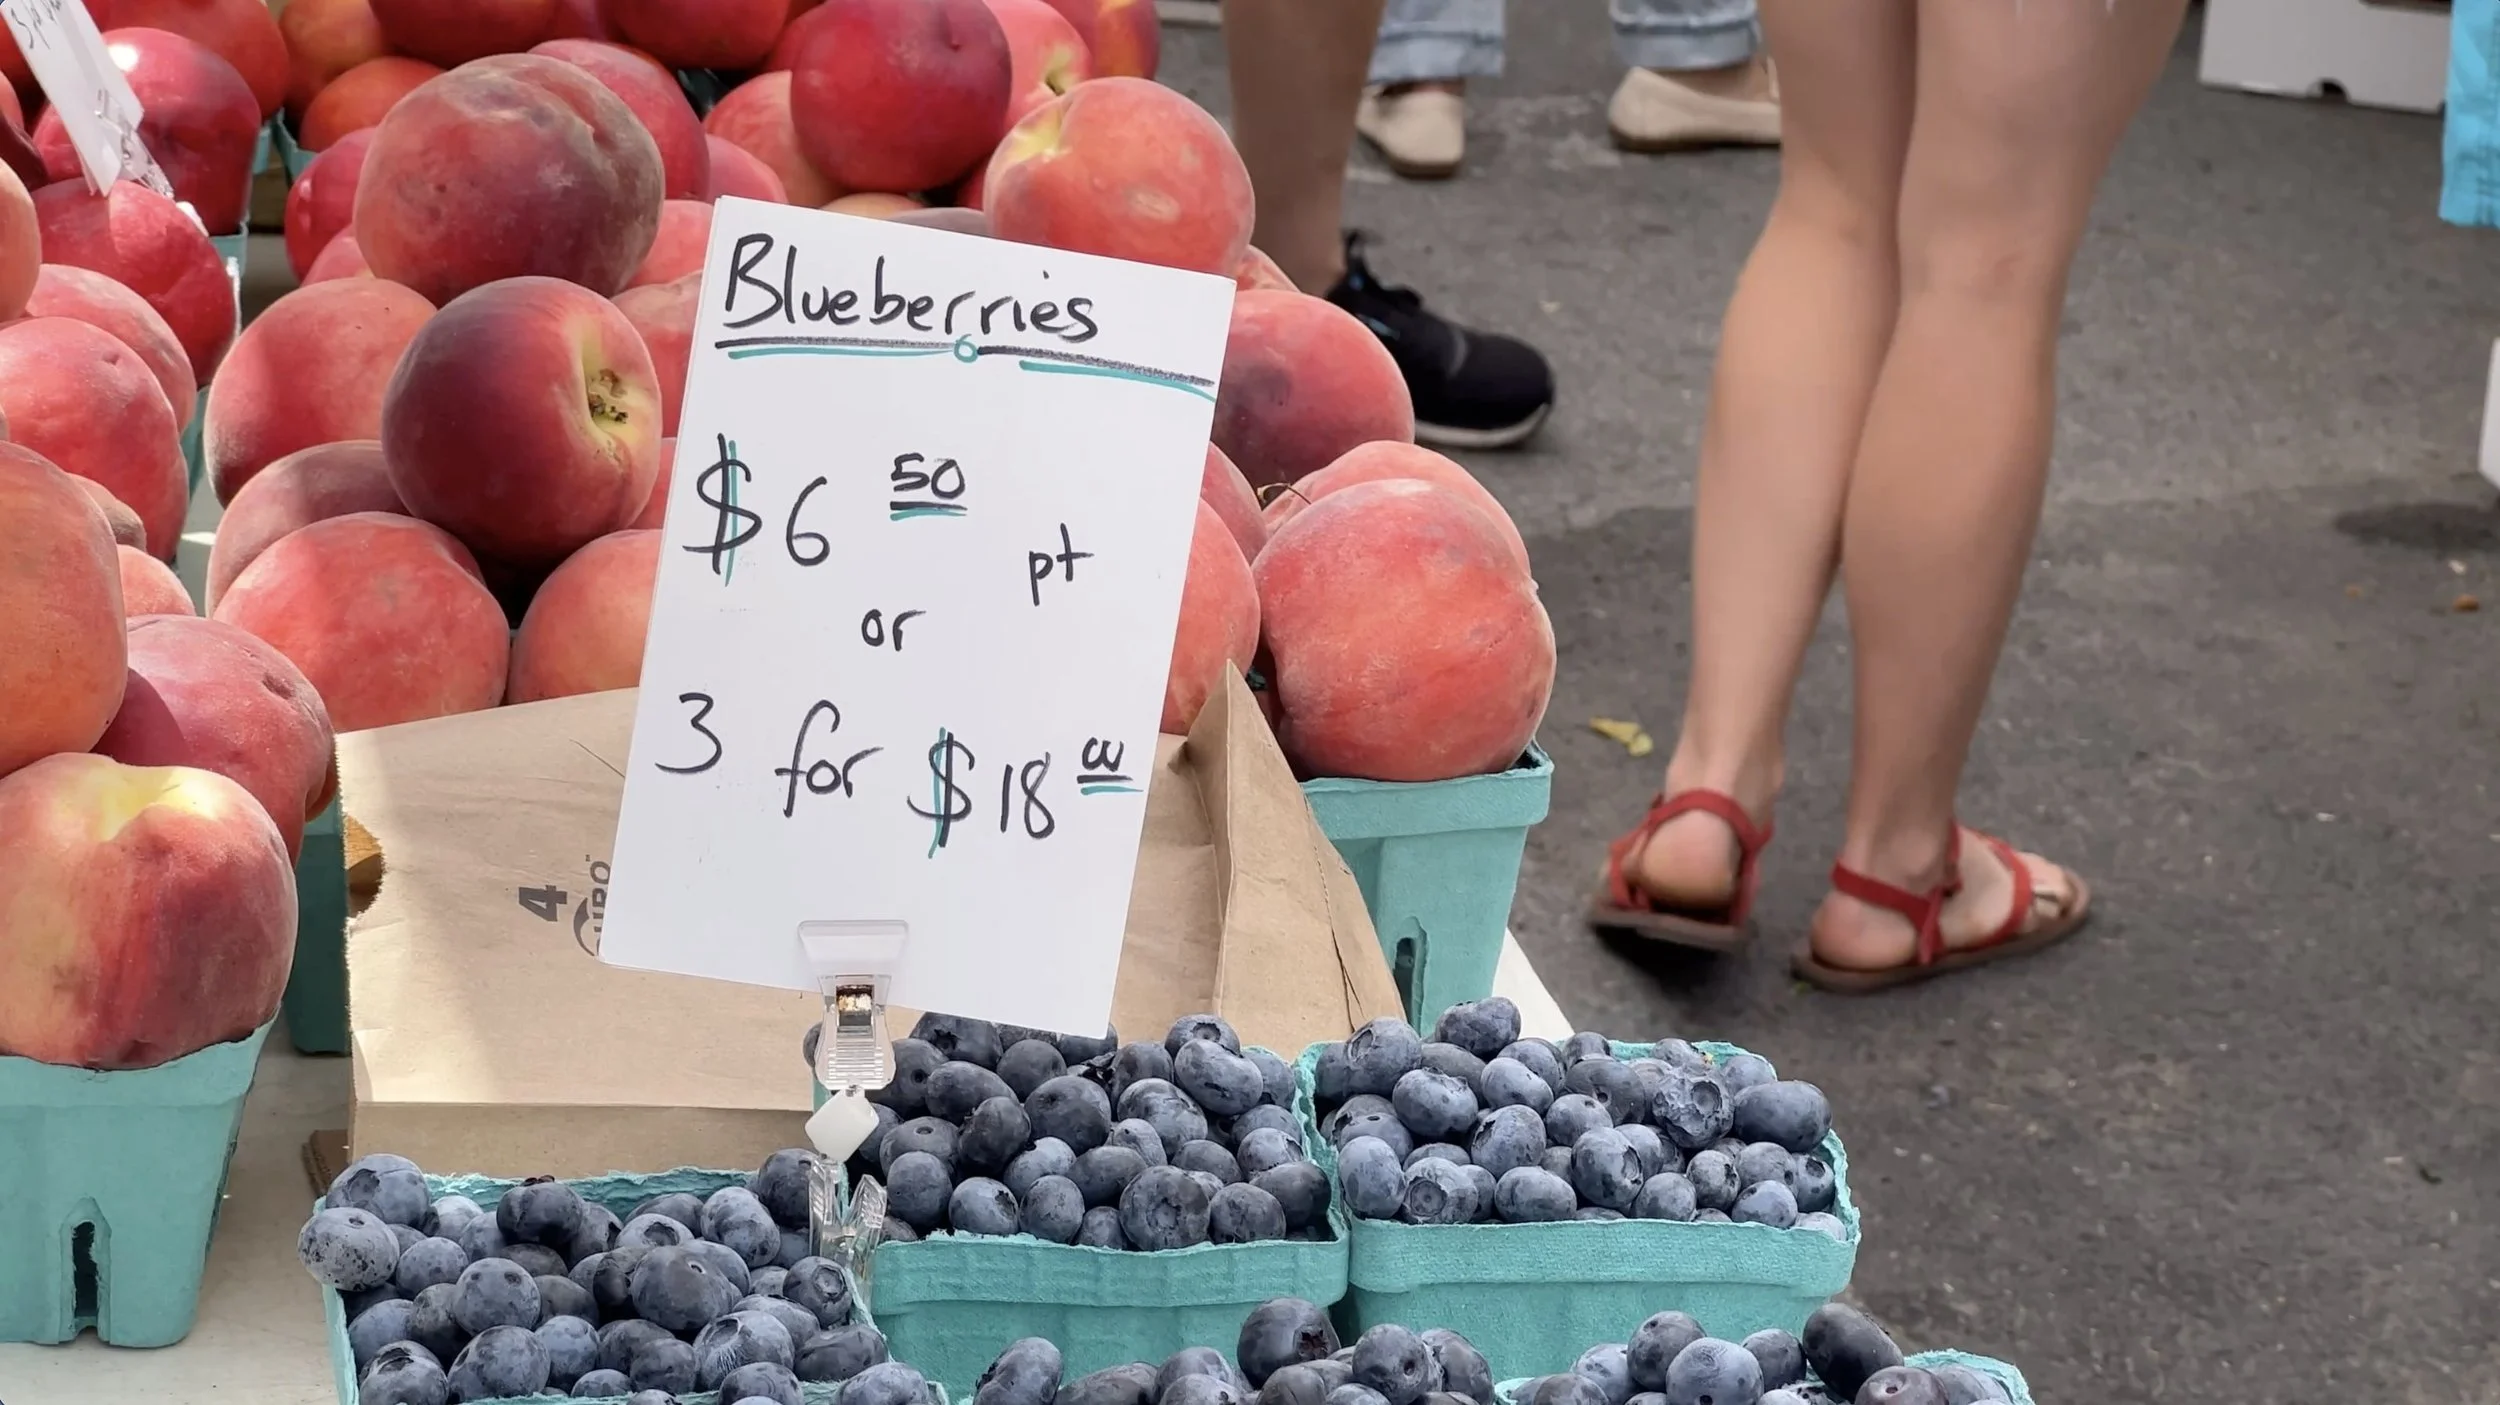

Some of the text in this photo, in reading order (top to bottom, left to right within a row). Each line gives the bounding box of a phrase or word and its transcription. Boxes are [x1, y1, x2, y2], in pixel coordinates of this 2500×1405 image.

[722, 232, 1099, 343] Blueberries
[890, 451, 967, 500] 50
[1028, 522, 1095, 606] pt
[860, 608, 926, 652] or
[654, 691, 723, 774] 3
[774, 699, 885, 818] for
[517, 883, 569, 923] 4
